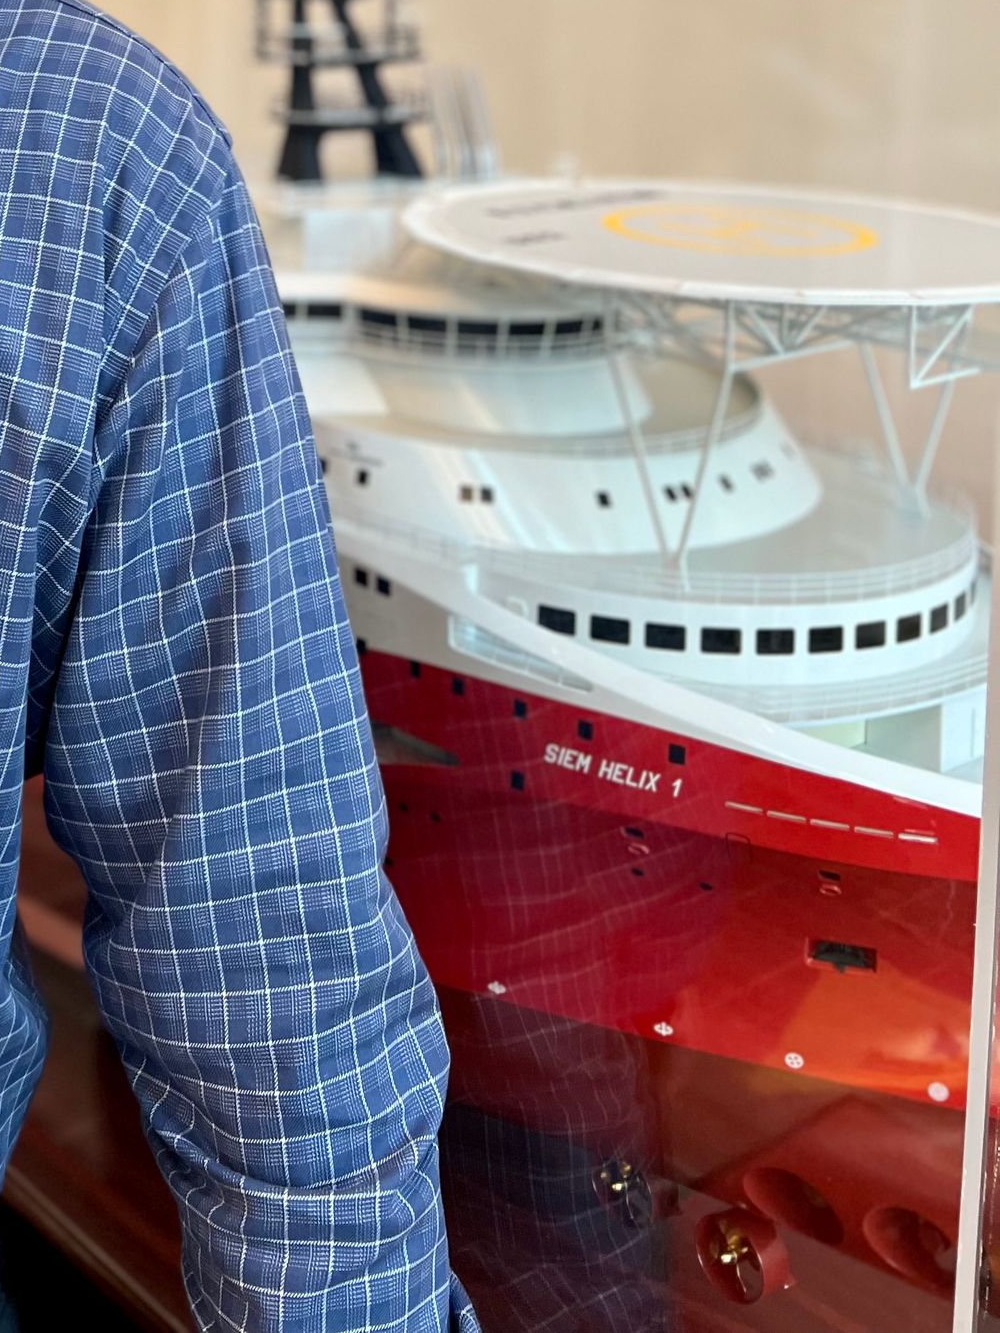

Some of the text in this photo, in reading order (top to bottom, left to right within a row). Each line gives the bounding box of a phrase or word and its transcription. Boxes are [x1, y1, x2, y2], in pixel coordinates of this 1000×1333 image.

[544, 743, 682, 798] SIEM HELIX 1
